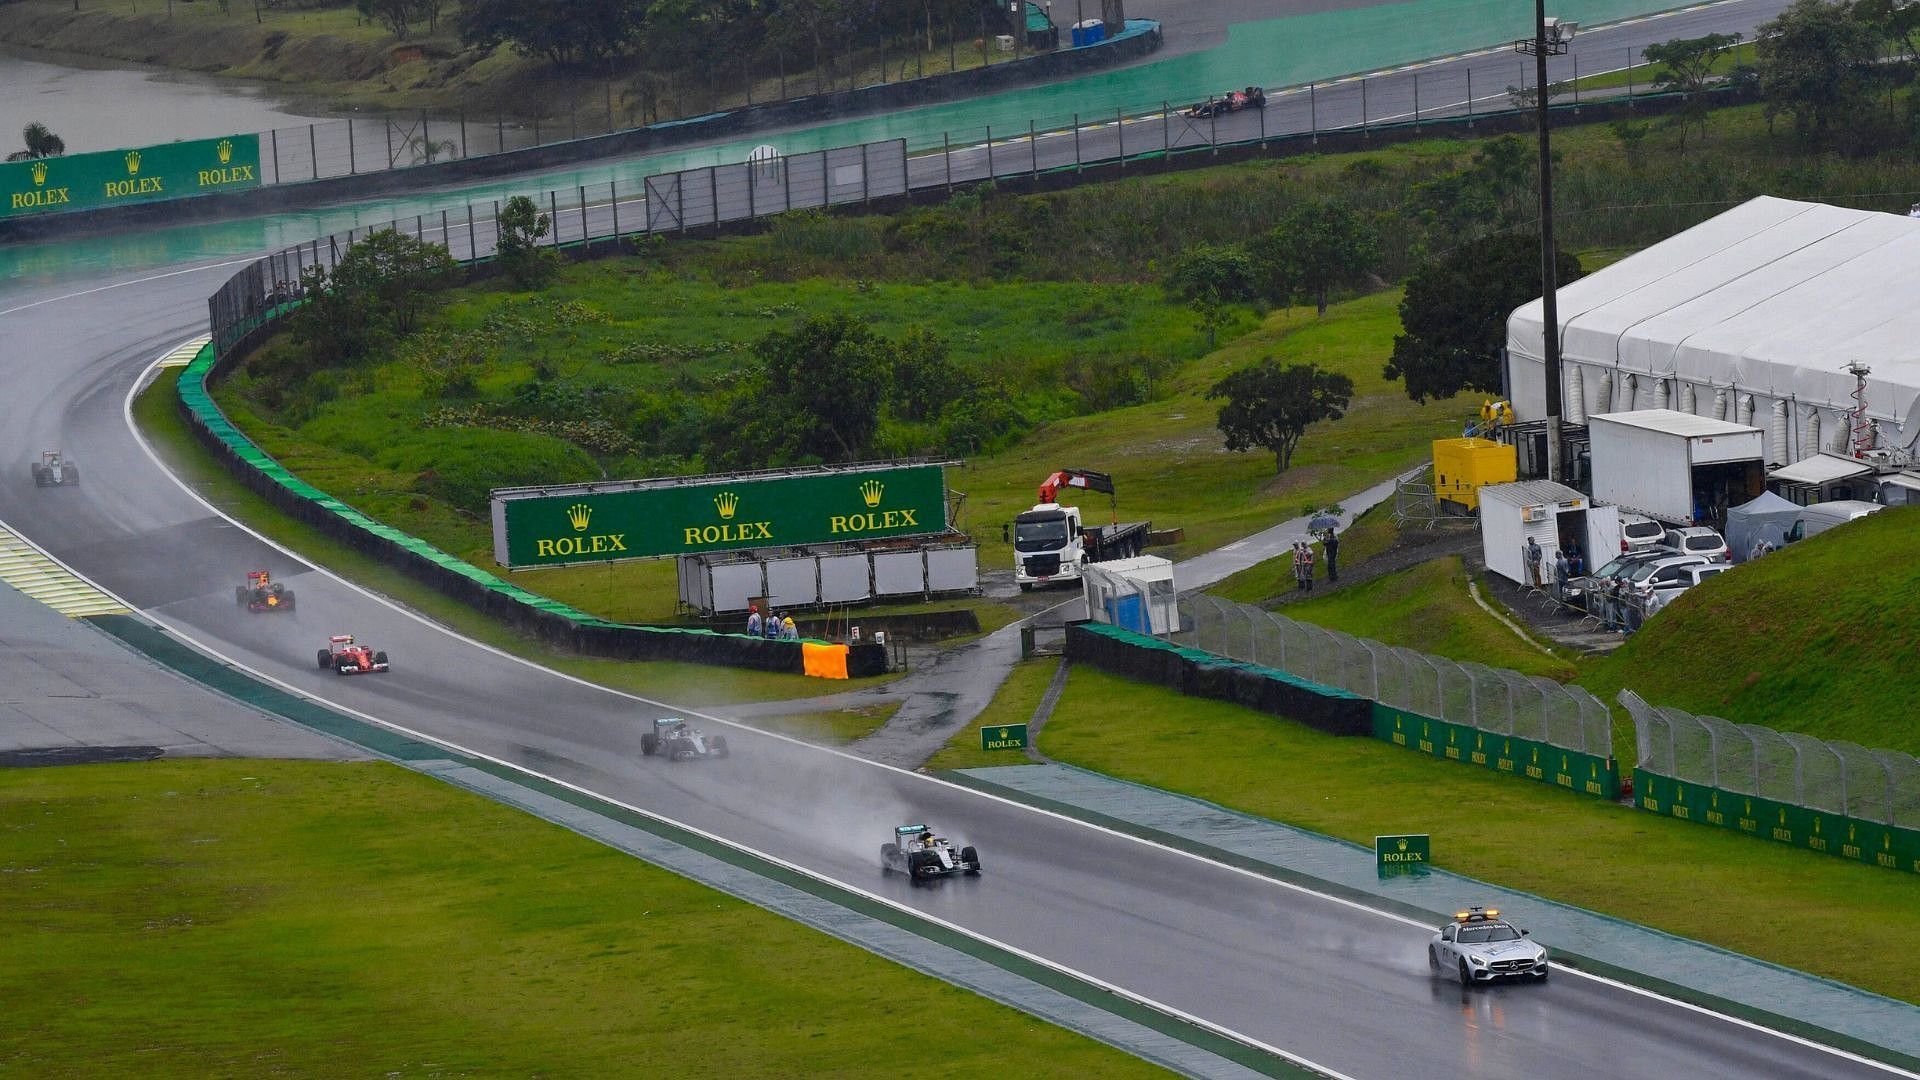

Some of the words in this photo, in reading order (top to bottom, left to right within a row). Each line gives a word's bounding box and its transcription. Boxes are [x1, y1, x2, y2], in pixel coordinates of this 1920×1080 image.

[198, 166, 254, 186] ROLEX
[106, 177, 163, 197] ROLEX
[12, 188, 69, 208] ROLEX
[830, 509, 919, 533] ROLEX
[684, 521, 773, 545] ROLEX
[537, 534, 627, 557] ROLEX
[988, 739, 1021, 749] ROLEX
[1383, 852, 1422, 862] ROLEX
